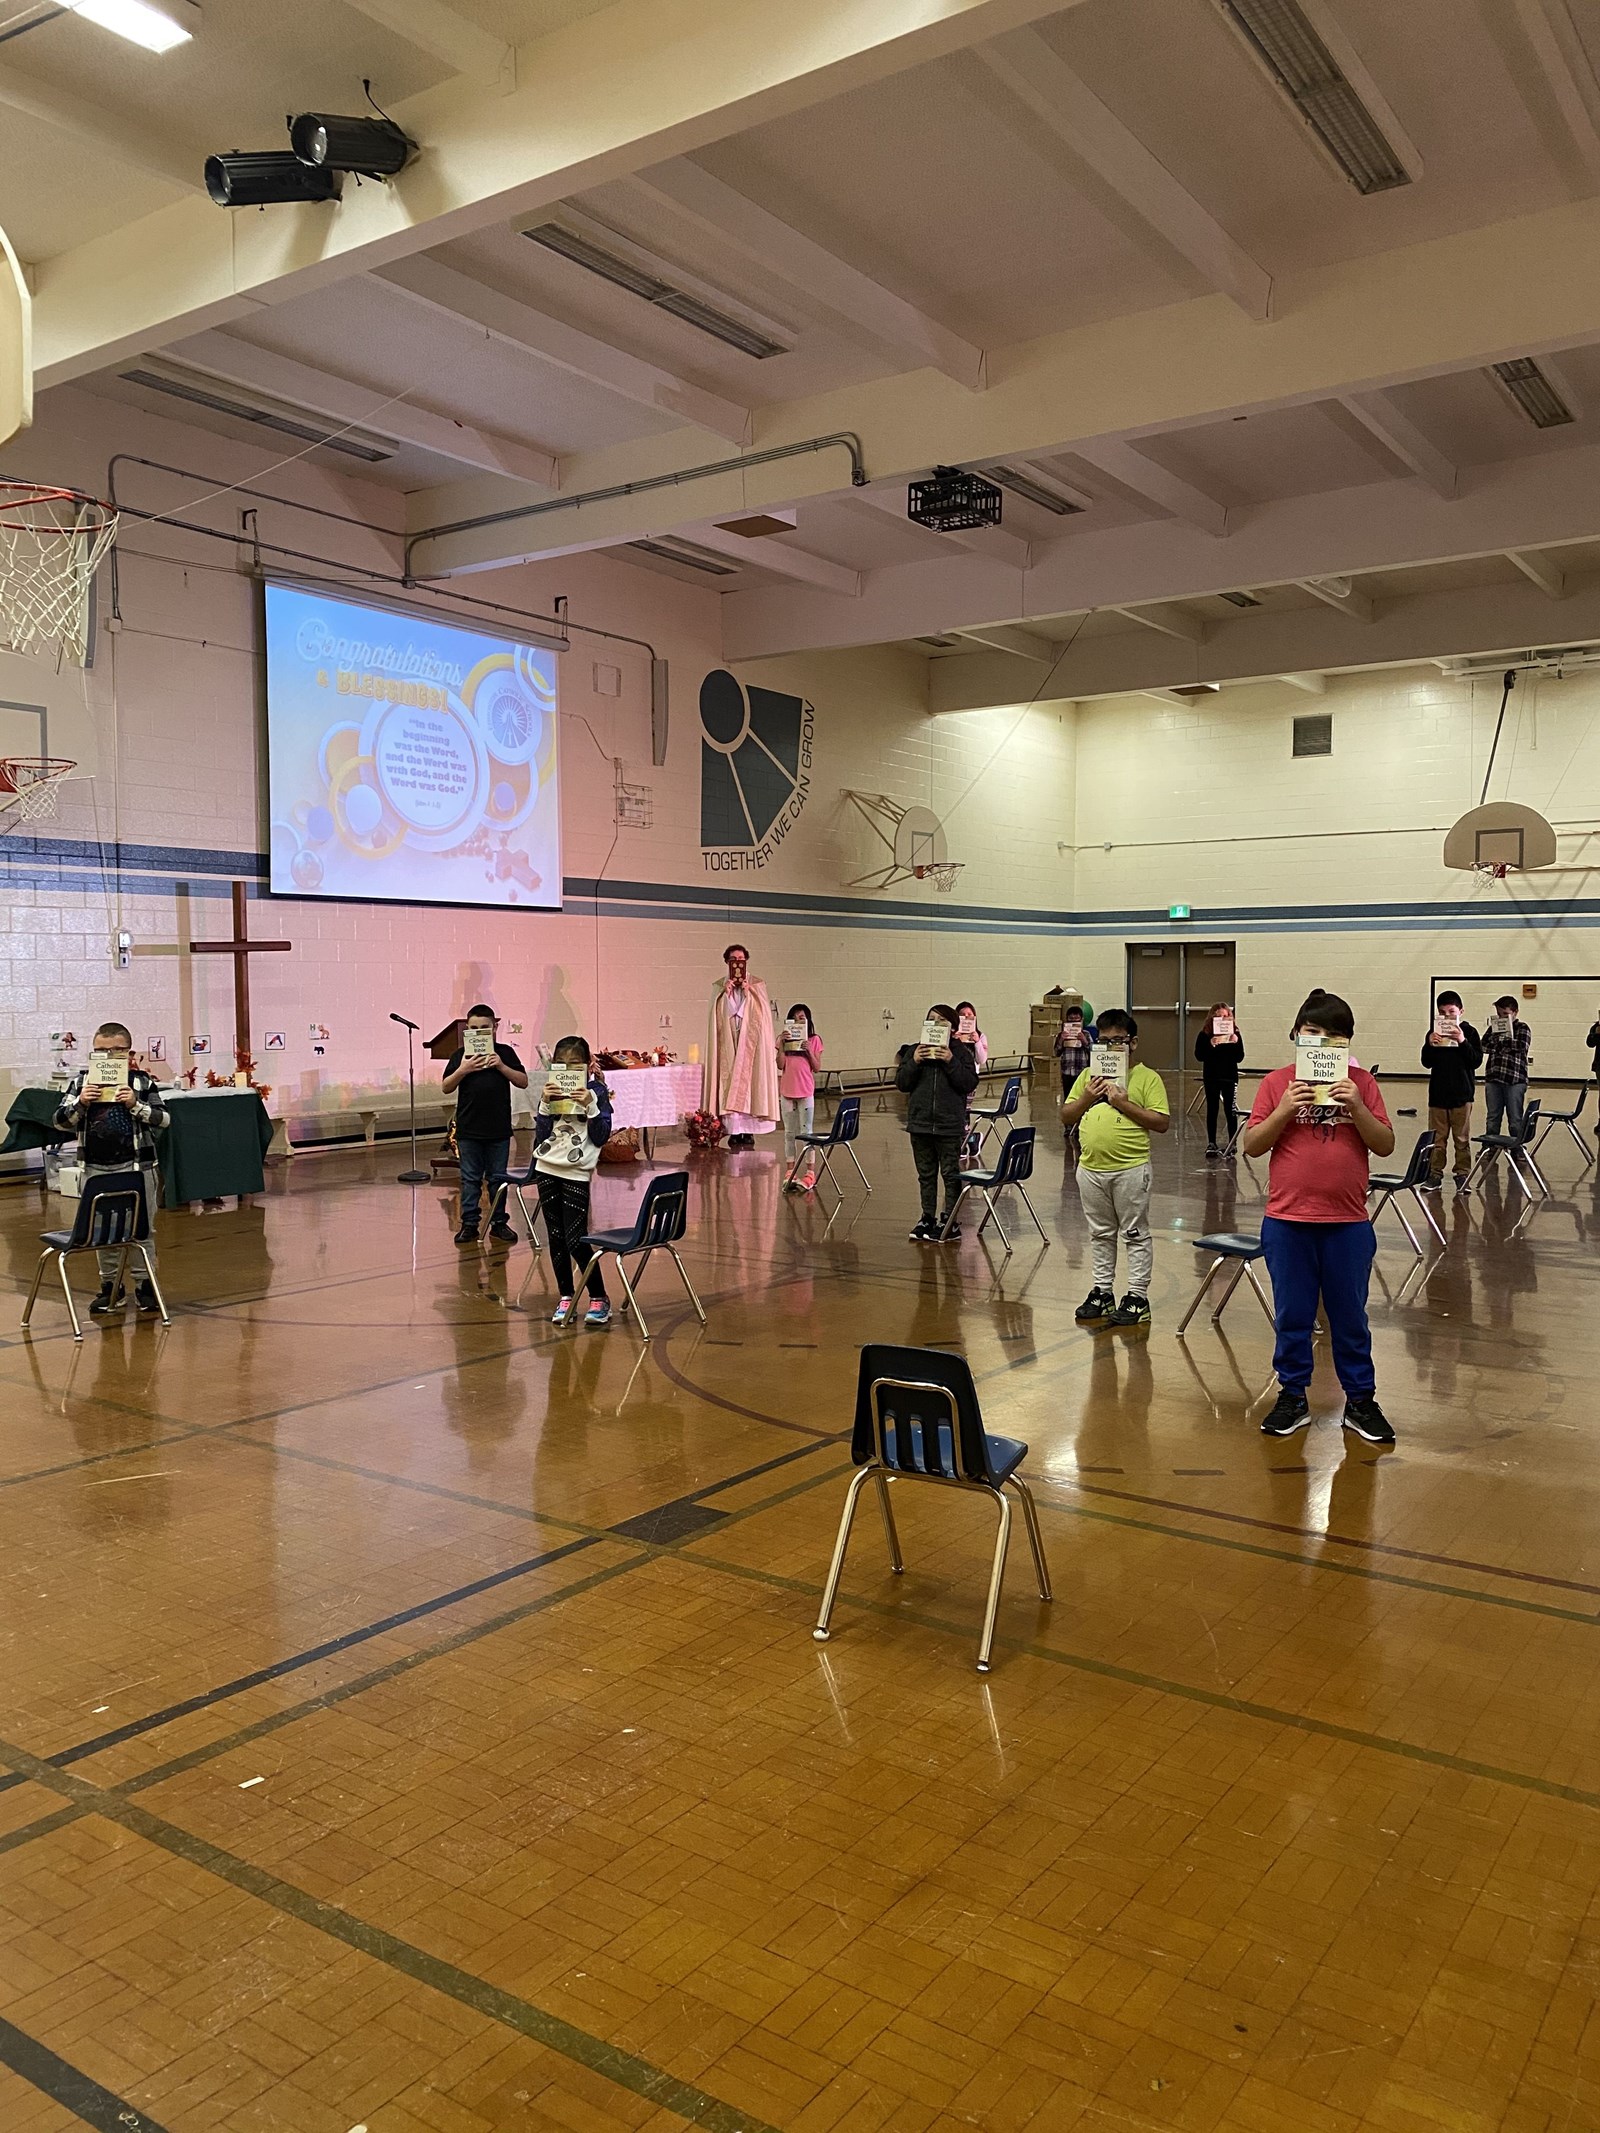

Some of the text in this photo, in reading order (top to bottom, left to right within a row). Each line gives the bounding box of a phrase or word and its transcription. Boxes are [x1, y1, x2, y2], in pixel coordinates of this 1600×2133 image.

[336, 671, 448, 713] BLESSINGS!
[428, 722, 443, 732] the
[403, 729, 450, 747] beginning
[394, 742, 459, 759] was the Word,
[385, 753, 467, 772] and the Word was
[386, 764, 467, 784] with God, and the
[390, 777, 417, 789] Word
[418, 781, 436, 792] was
[702, 699, 815, 871] TOGETHER WE CAN GROW
[1306, 1051, 1342, 1061] Catholic
[1312, 1060, 1336, 1069] Youth
[1313, 1069, 1335, 1078] Bible
